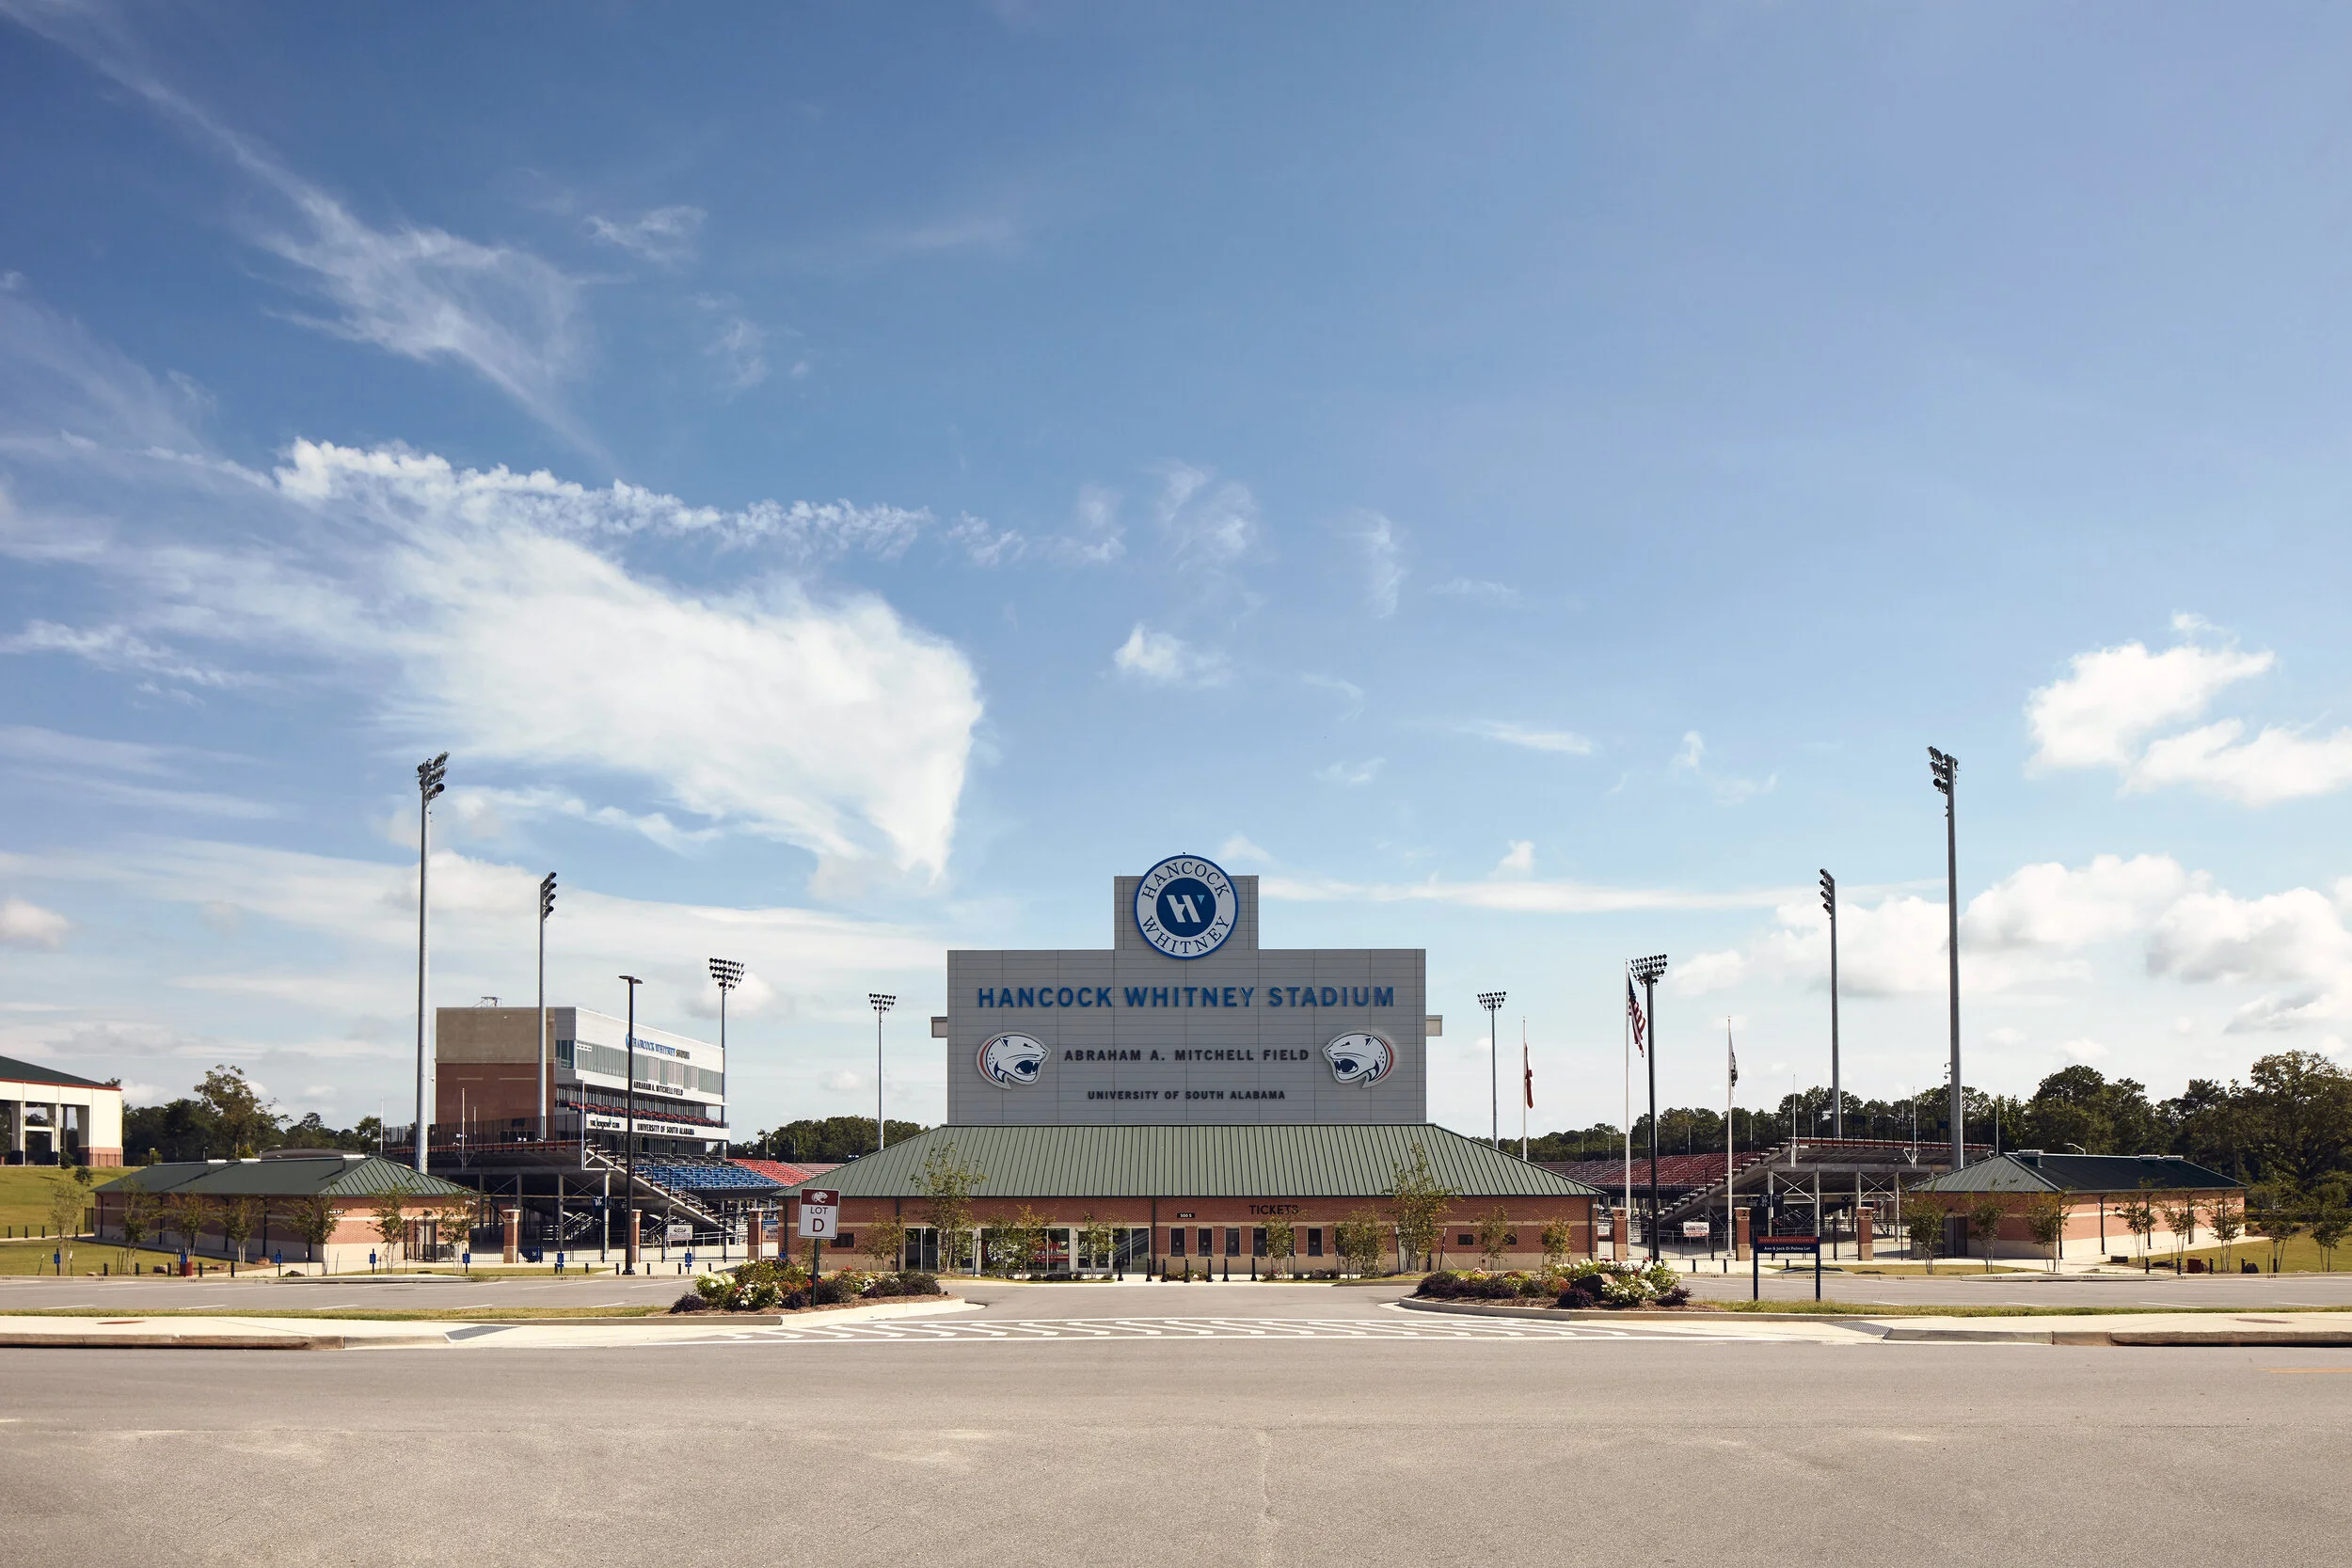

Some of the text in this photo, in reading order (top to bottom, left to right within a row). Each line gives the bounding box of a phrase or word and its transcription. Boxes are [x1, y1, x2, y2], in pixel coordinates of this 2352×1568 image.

[1141, 861, 1231, 900] HANCOCK
[1142, 915, 1230, 954] WHITNEY
[977, 986, 1394, 1008] HANCOCK WHITNEY STADIUM
[656, 1043, 676, 1057] WHITNEY
[1064, 1049, 1310, 1061] ABRAHAM A. MITCHELL FIELD
[633, 1081, 652, 1091] ABRAHAM
[656, 1085, 674, 1095] MITCHELL
[674, 1087, 684, 1096] FIELD
[1088, 1090, 1286, 1100] UNIVERSITY OF SOUTH ALABAMA
[637, 1123, 660, 1132] UNIVERSITY
[660, 1125, 666, 1133] OF
[666, 1126, 678, 1134] SOUTH
[810, 1206, 828, 1214] LOT
[1248, 1204, 1298, 1215] TICKETS
[812, 1218, 824, 1232] D
